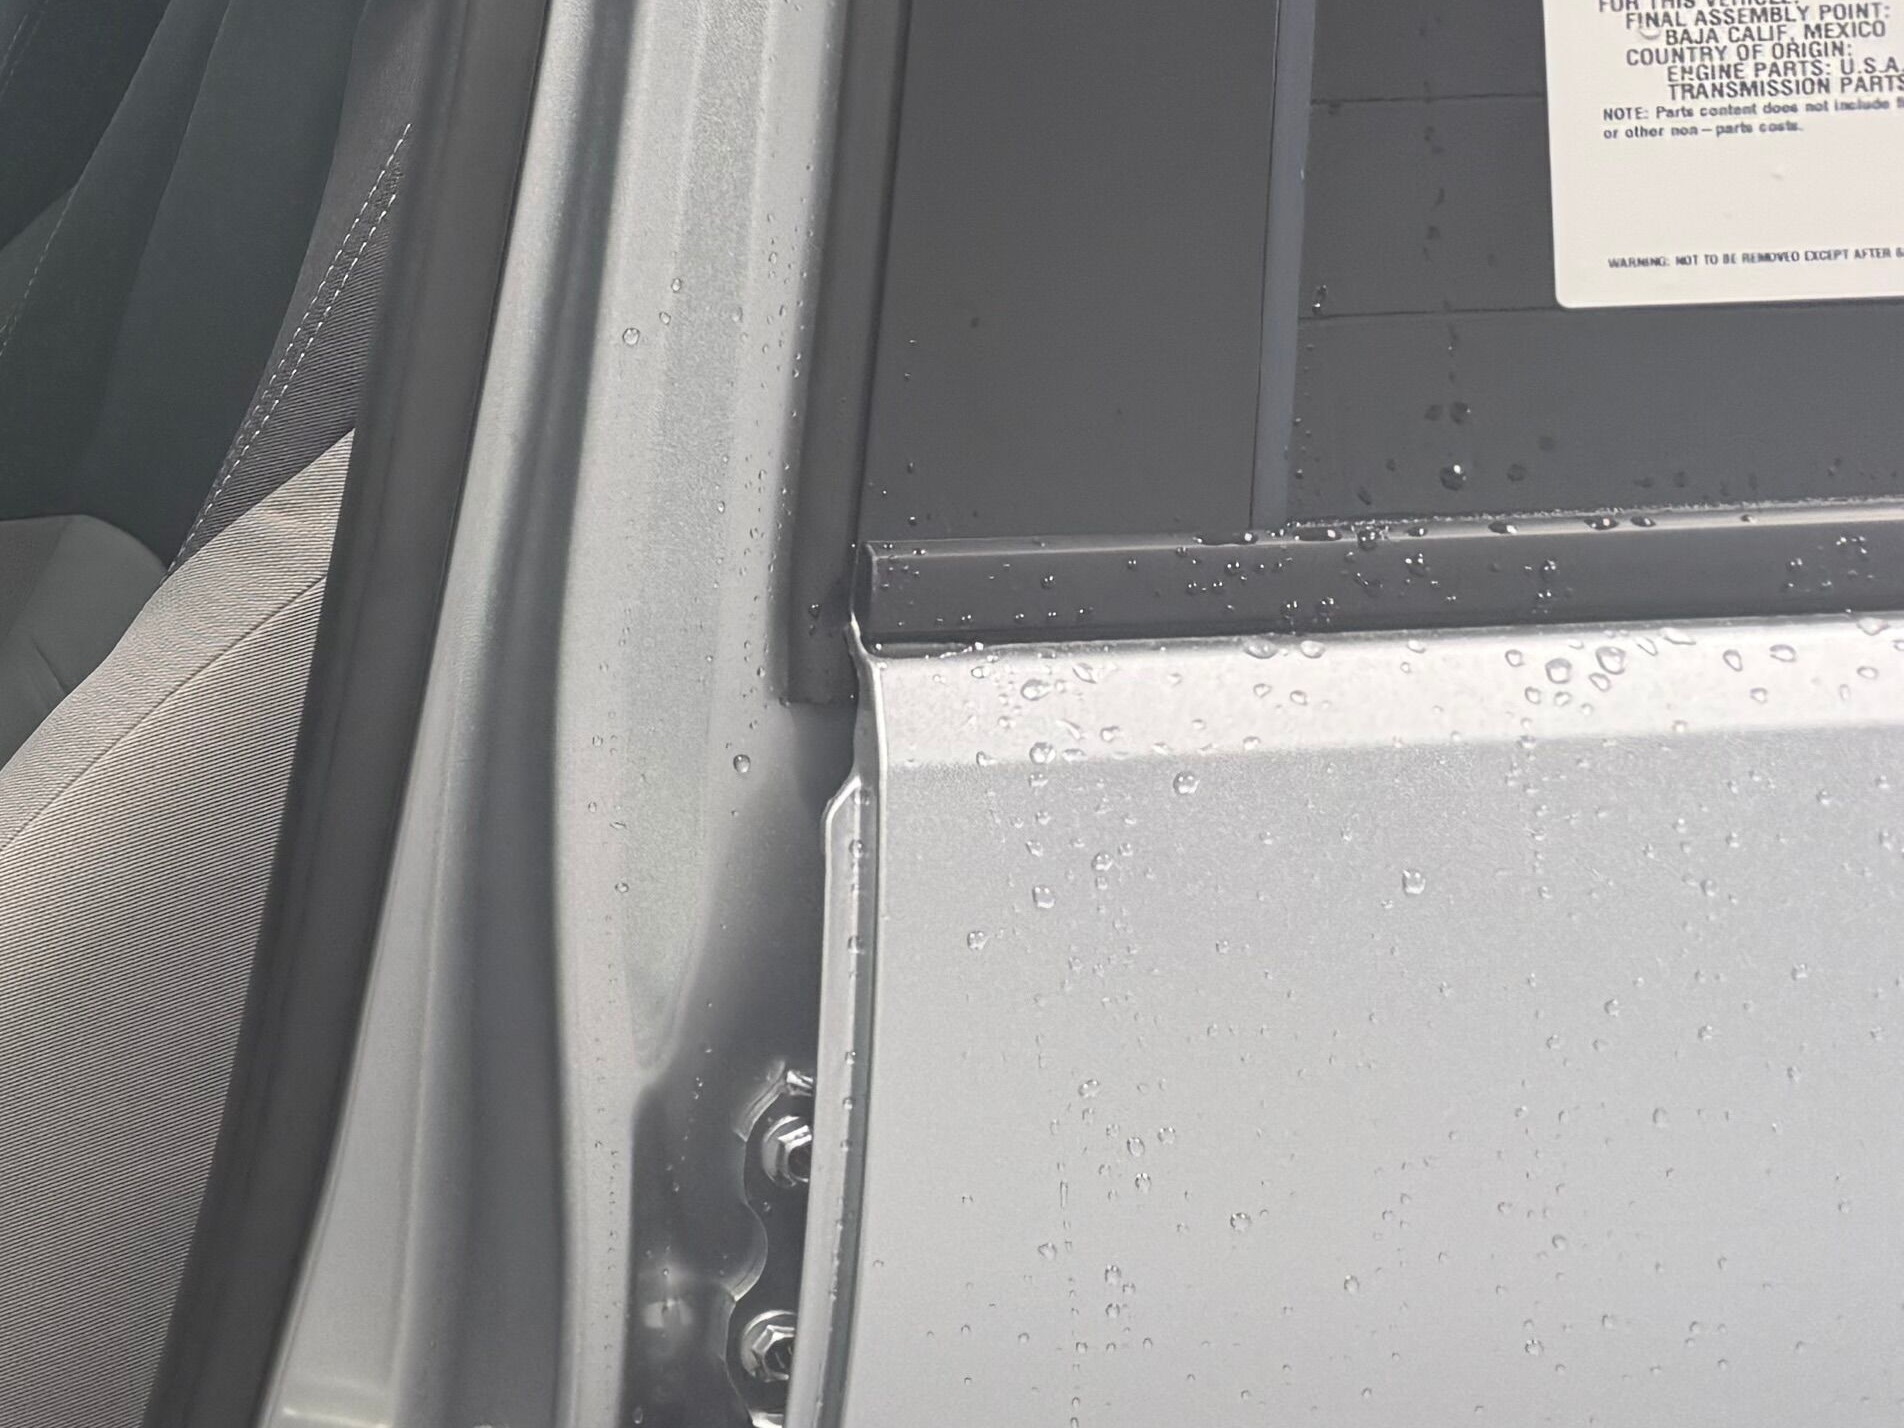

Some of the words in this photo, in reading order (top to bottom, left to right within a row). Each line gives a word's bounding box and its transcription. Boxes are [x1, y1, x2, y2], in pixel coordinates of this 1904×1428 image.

[1626, 11, 1687, 30] FINAL
[1694, 5, 1810, 27] ASSEMBLY
[1819, 2, 1891, 21] POINT:
[1665, 26, 1720, 47] BAJA
[1804, 21, 1887, 41] MEXICO
[1626, 45, 1728, 66] COUNTRY
[1736, 44, 1764, 62] OF
[1772, 41, 1853, 61] ORIGIN:
[1667, 62, 1745, 83] ENGINE
[1754, 59, 1832, 79] PARTS:
[1668, 77, 1831, 101] TRANSMISSION
[1840, 74, 1904, 94] PARTS
[1603, 106, 1649, 121] NOTE:
[1655, 105, 1693, 120] Parts
[1700, 102, 1756, 118] content
[1762, 101, 1798, 115] does
[1805, 100, 1829, 114] not
[1834, 98, 1890, 112] include
[1603, 128, 1618, 140] or
[1625, 124, 1664, 139] other
[1675, 253, 1698, 267] NOT
[1704, 253, 1719, 266] TO
[1723, 252, 1737, 265] BE
[1741, 250, 1800, 264] REMOVED
[1804, 247, 1849, 263] EXCEPT
[1854, 247, 1891, 261] AFTER
